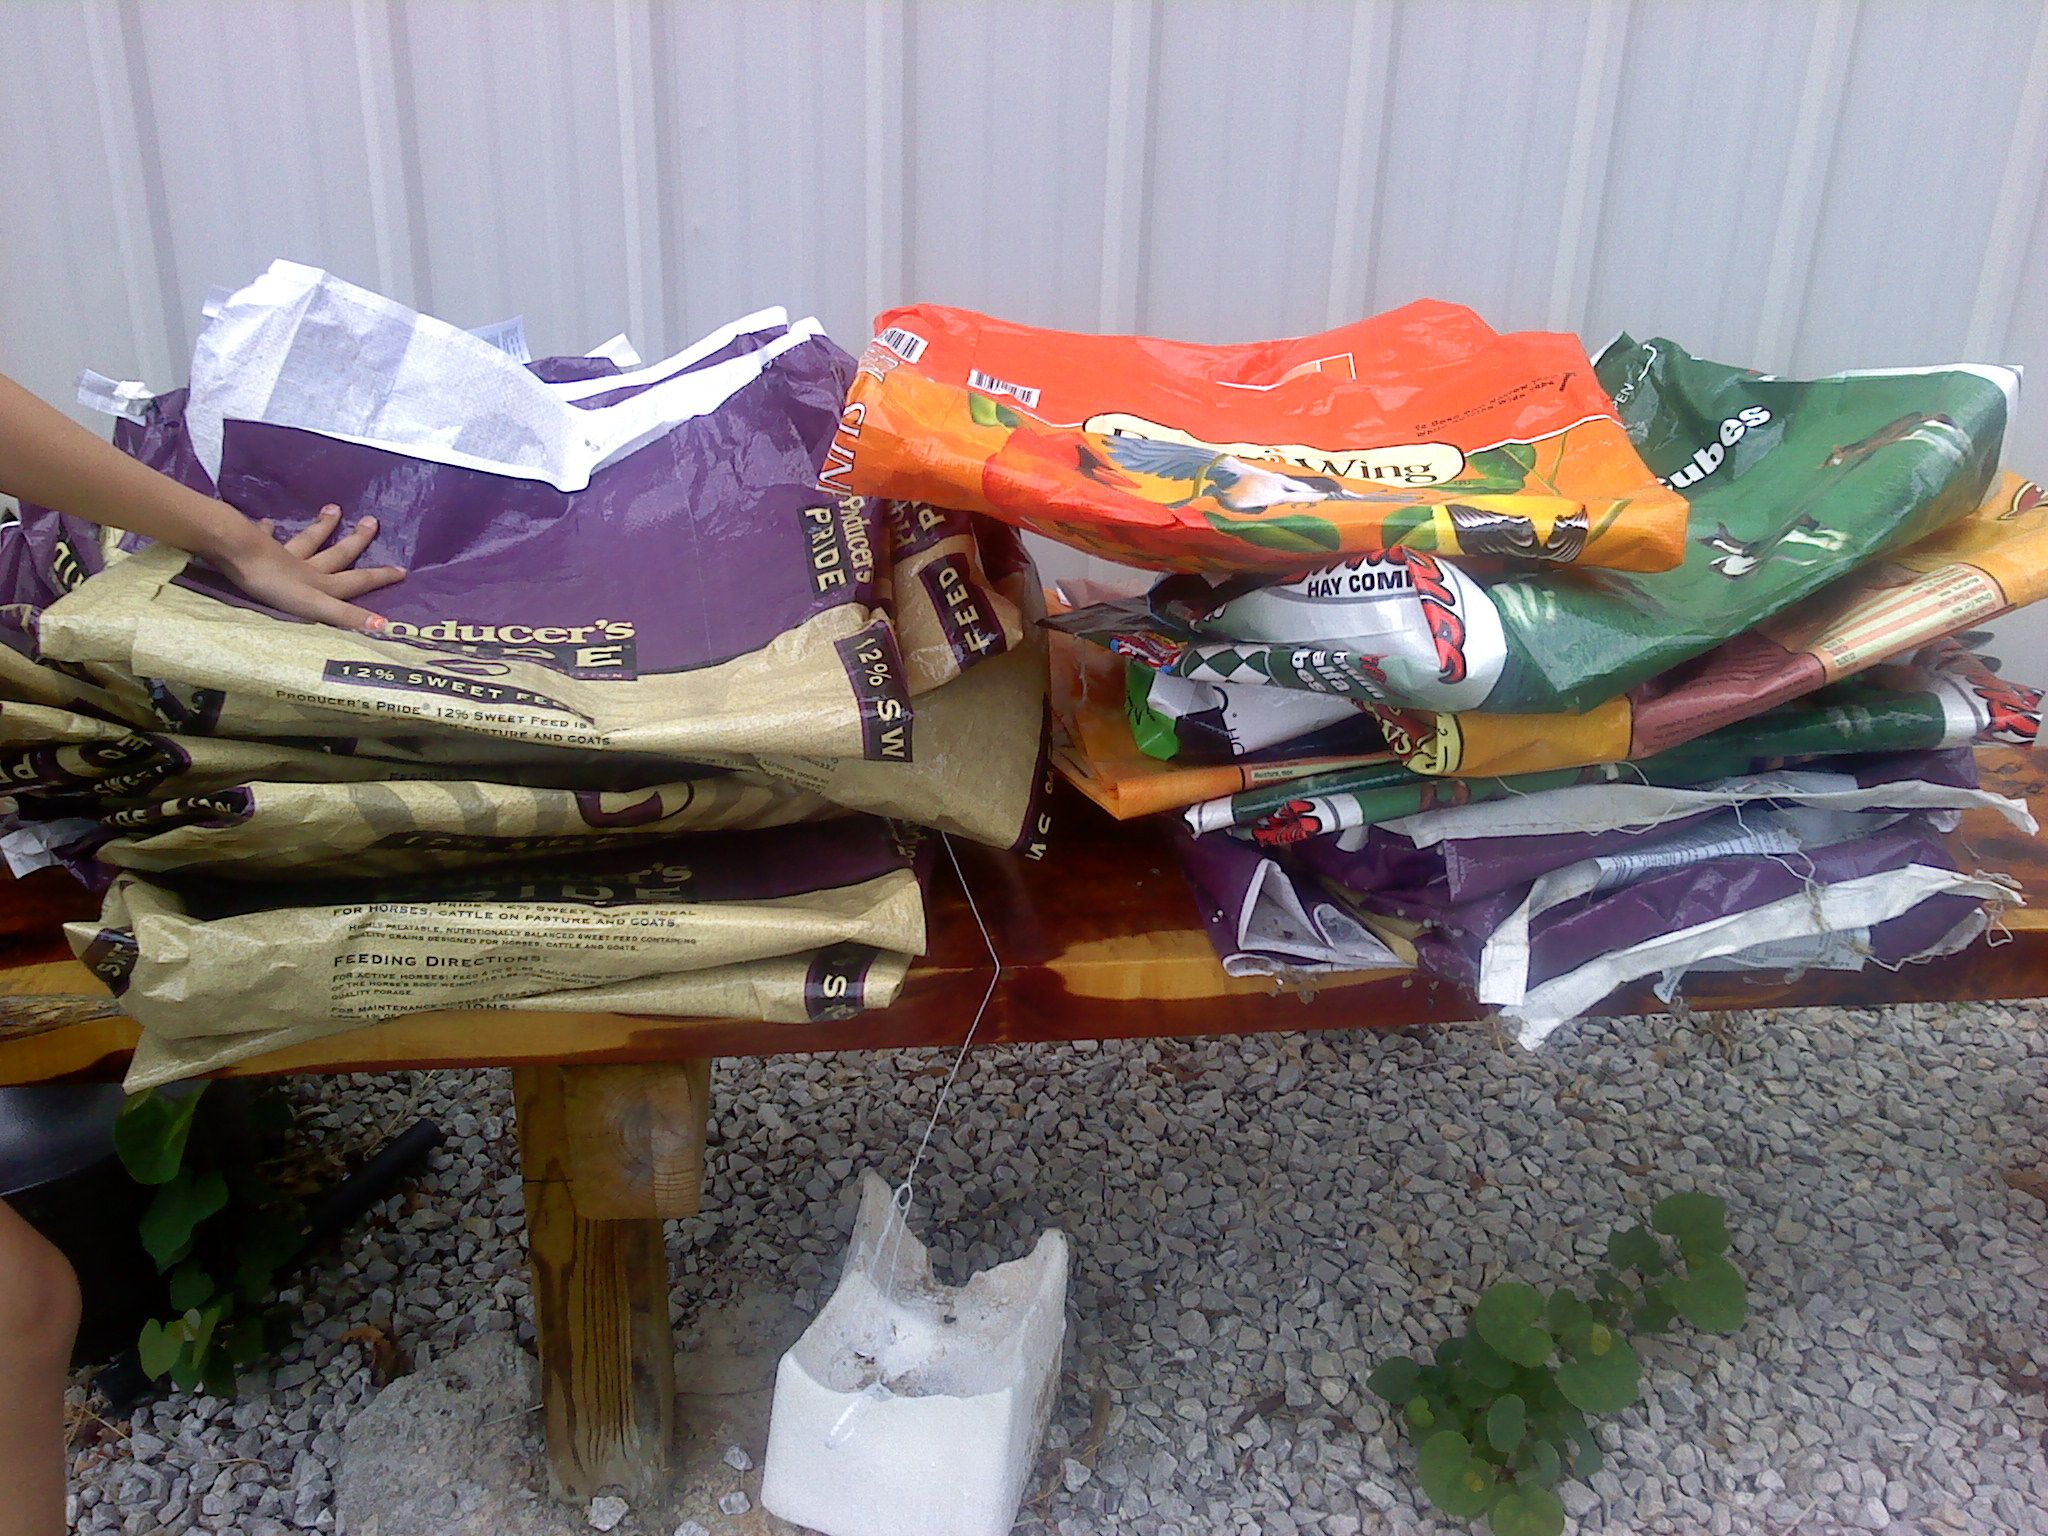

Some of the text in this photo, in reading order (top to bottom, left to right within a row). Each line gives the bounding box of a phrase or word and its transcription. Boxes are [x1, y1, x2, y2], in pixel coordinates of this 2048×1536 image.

[804, 508, 847, 592] PRIDE
[1307, 576, 1343, 598] HAY
[938, 566, 992, 652] FEED
[385, 618, 636, 644] oducer's
[855, 638, 893, 687] 12%
[340, 663, 396, 682] 12%
[407, 671, 503, 700] SWEET
[276, 689, 372, 710] PRODUCER'S
[376, 700, 421, 716] PRIDE
[437, 706, 470, 720] 12%
[474, 710, 526, 725] SWEET
[530, 715, 569, 728] FEED
[534, 732, 564, 743] AND
[568, 734, 616, 747] GOATS.
[333, 907, 362, 916] FOR
[438, 910, 493, 921] CATTLE
[498, 912, 519, 921] ON
[525, 914, 591, 925] PASTURE
[597, 918, 625, 926] AND
[427, 936, 477, 945] DESIGNED
[546, 942, 581, 950] CATTLE
[524, 931, 574, 940] BALANCED
[577, 932, 610, 941] SWEET
[613, 935, 638, 943] FEED
[333, 953, 417, 968] FEEDING
[332, 972, 353, 983] FOR
[357, 971, 396, 980] ACTIVE
